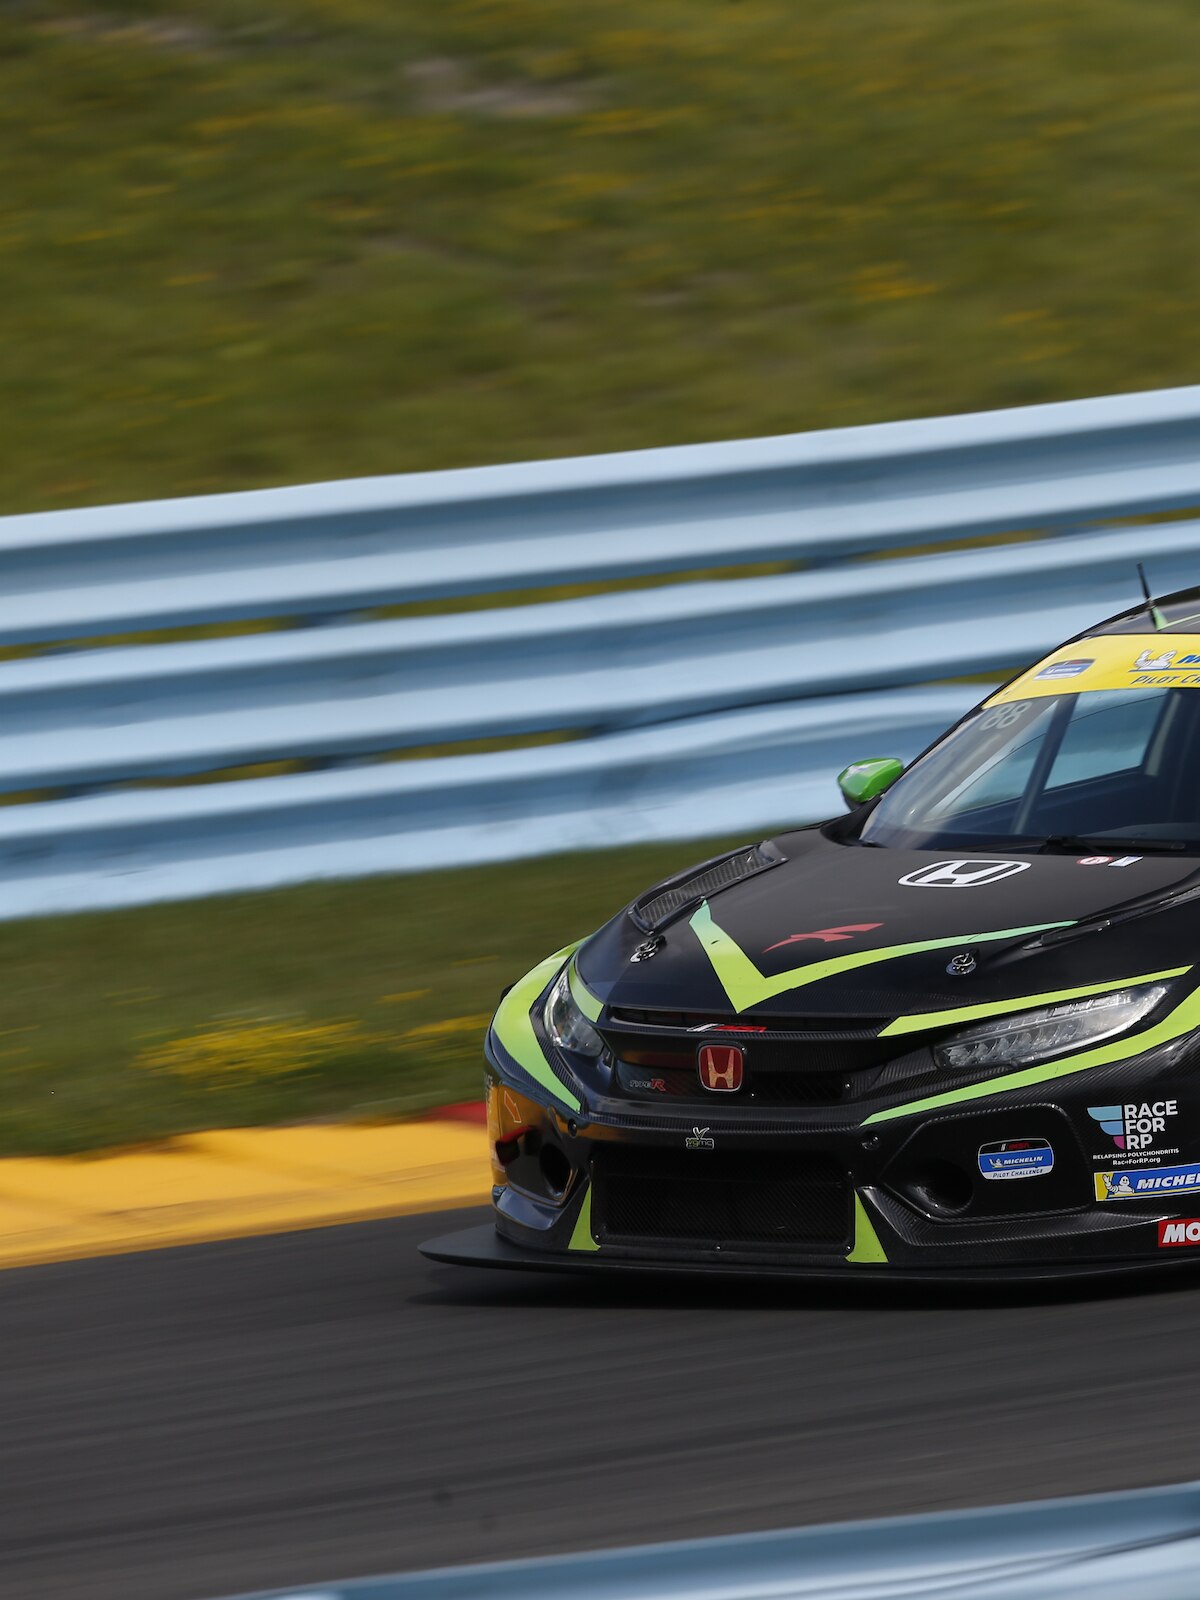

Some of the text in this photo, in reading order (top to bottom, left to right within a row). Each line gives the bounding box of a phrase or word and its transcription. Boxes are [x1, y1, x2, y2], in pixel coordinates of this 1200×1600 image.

[1130, 675, 1180, 685] PILOT
[979, 701, 1033, 731] 88
[1124, 1100, 1178, 1119] RACE
[1125, 1117, 1166, 1135] FOR
[1126, 1134, 1153, 1150] RP
[1127, 1148, 1180, 1158] POLYCHONDRITIS
[1003, 1156, 1044, 1165] MICHELIN
[1112, 1157, 1161, 1166] RaceForRP.org
